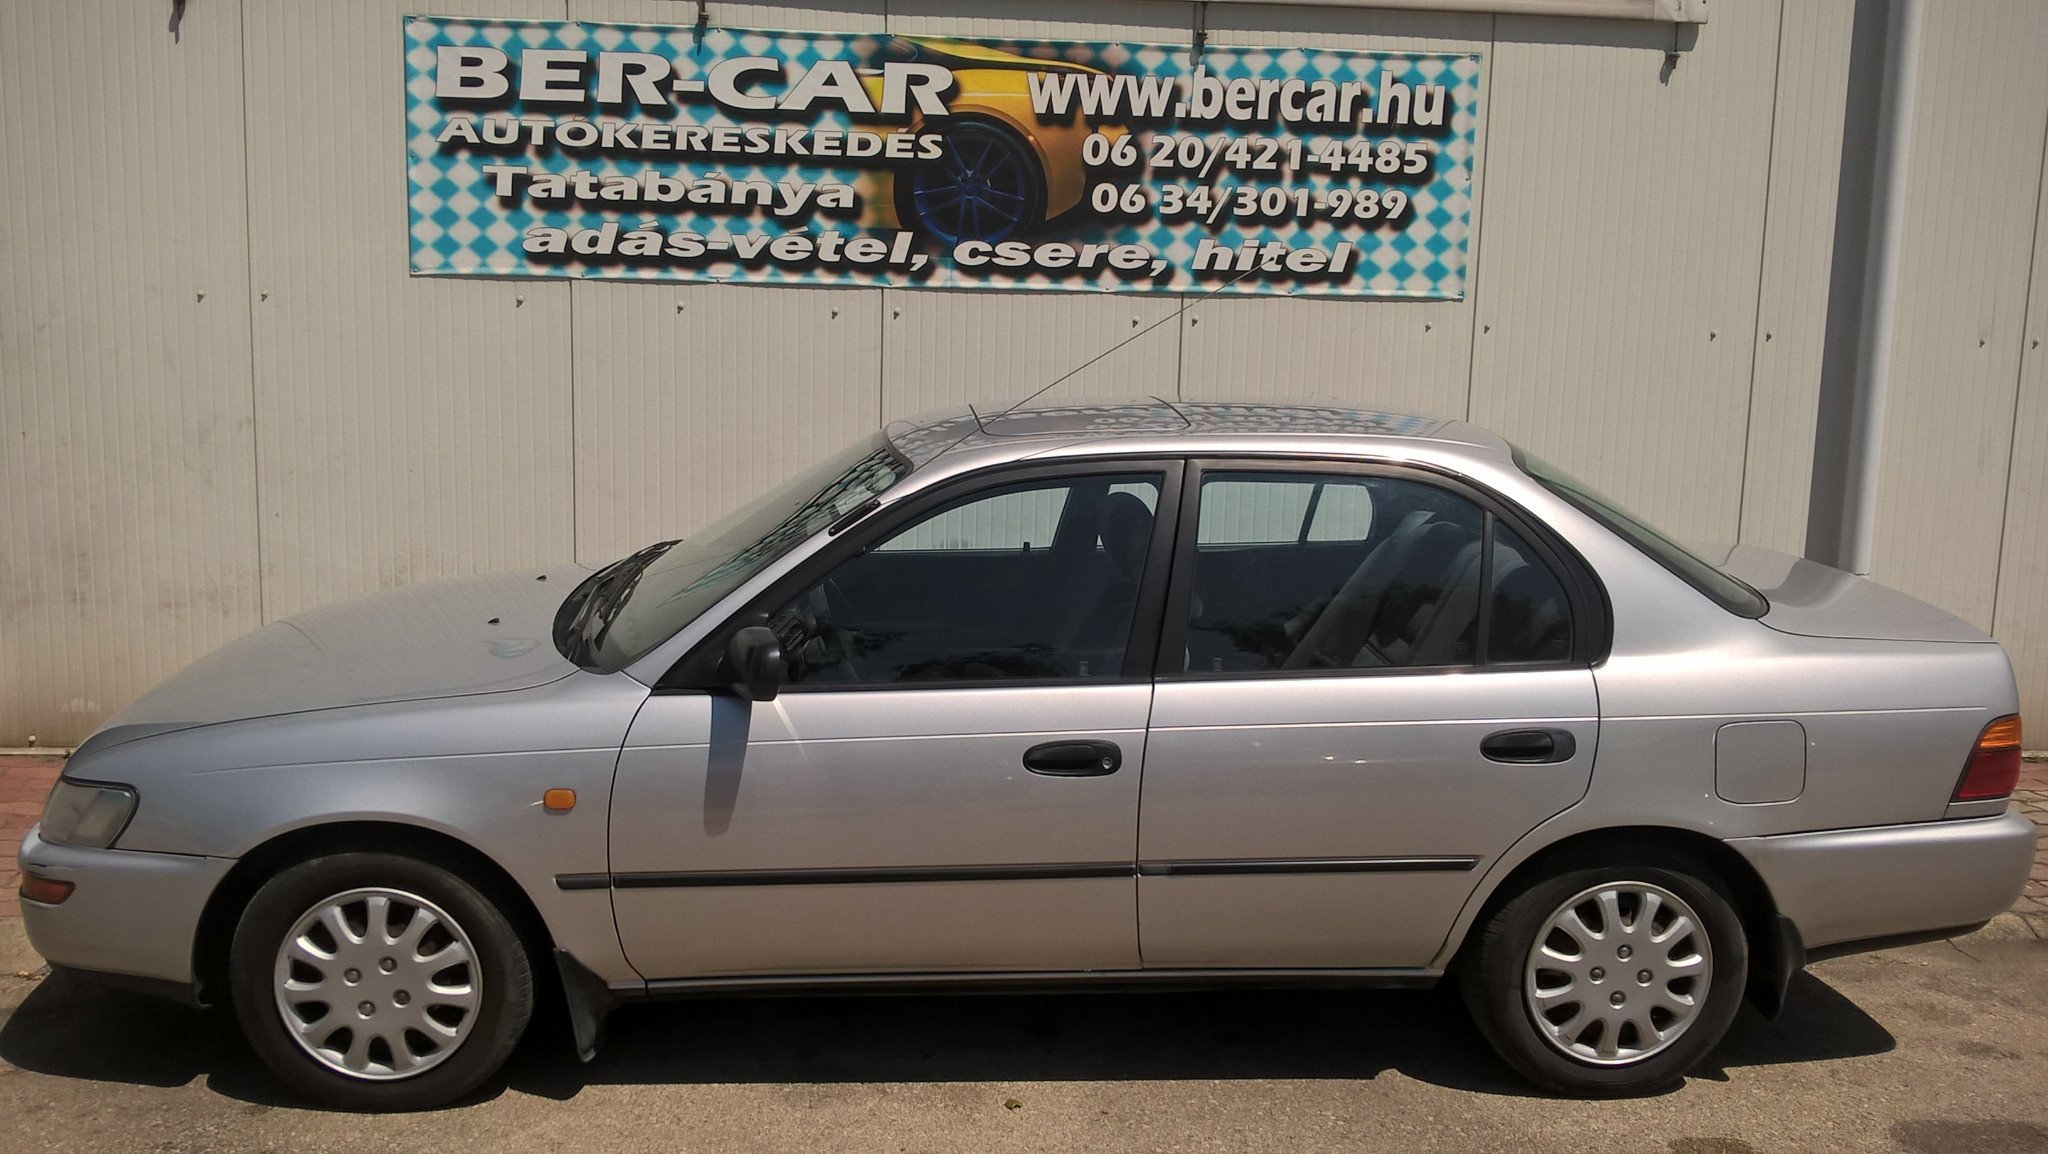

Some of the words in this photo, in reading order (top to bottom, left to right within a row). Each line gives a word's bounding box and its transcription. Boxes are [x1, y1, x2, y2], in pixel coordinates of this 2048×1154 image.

[434, 44, 956, 117] BER-CAR
[1026, 63, 1446, 127] www.bercar.hu
[435, 114, 944, 161] AUTÓKERESKEDÉS
[1081, 133, 1138, 168] 06
[1148, 135, 1430, 179] 20/421-4485
[482, 164, 855, 216] Tatabánya
[1090, 182, 1147, 214] 06
[1157, 184, 1409, 224] 34/301-989
[521, 219, 930, 273] adás-vétel,
[951, 239, 1169, 277] csere,
[1190, 237, 1354, 274] hitel
